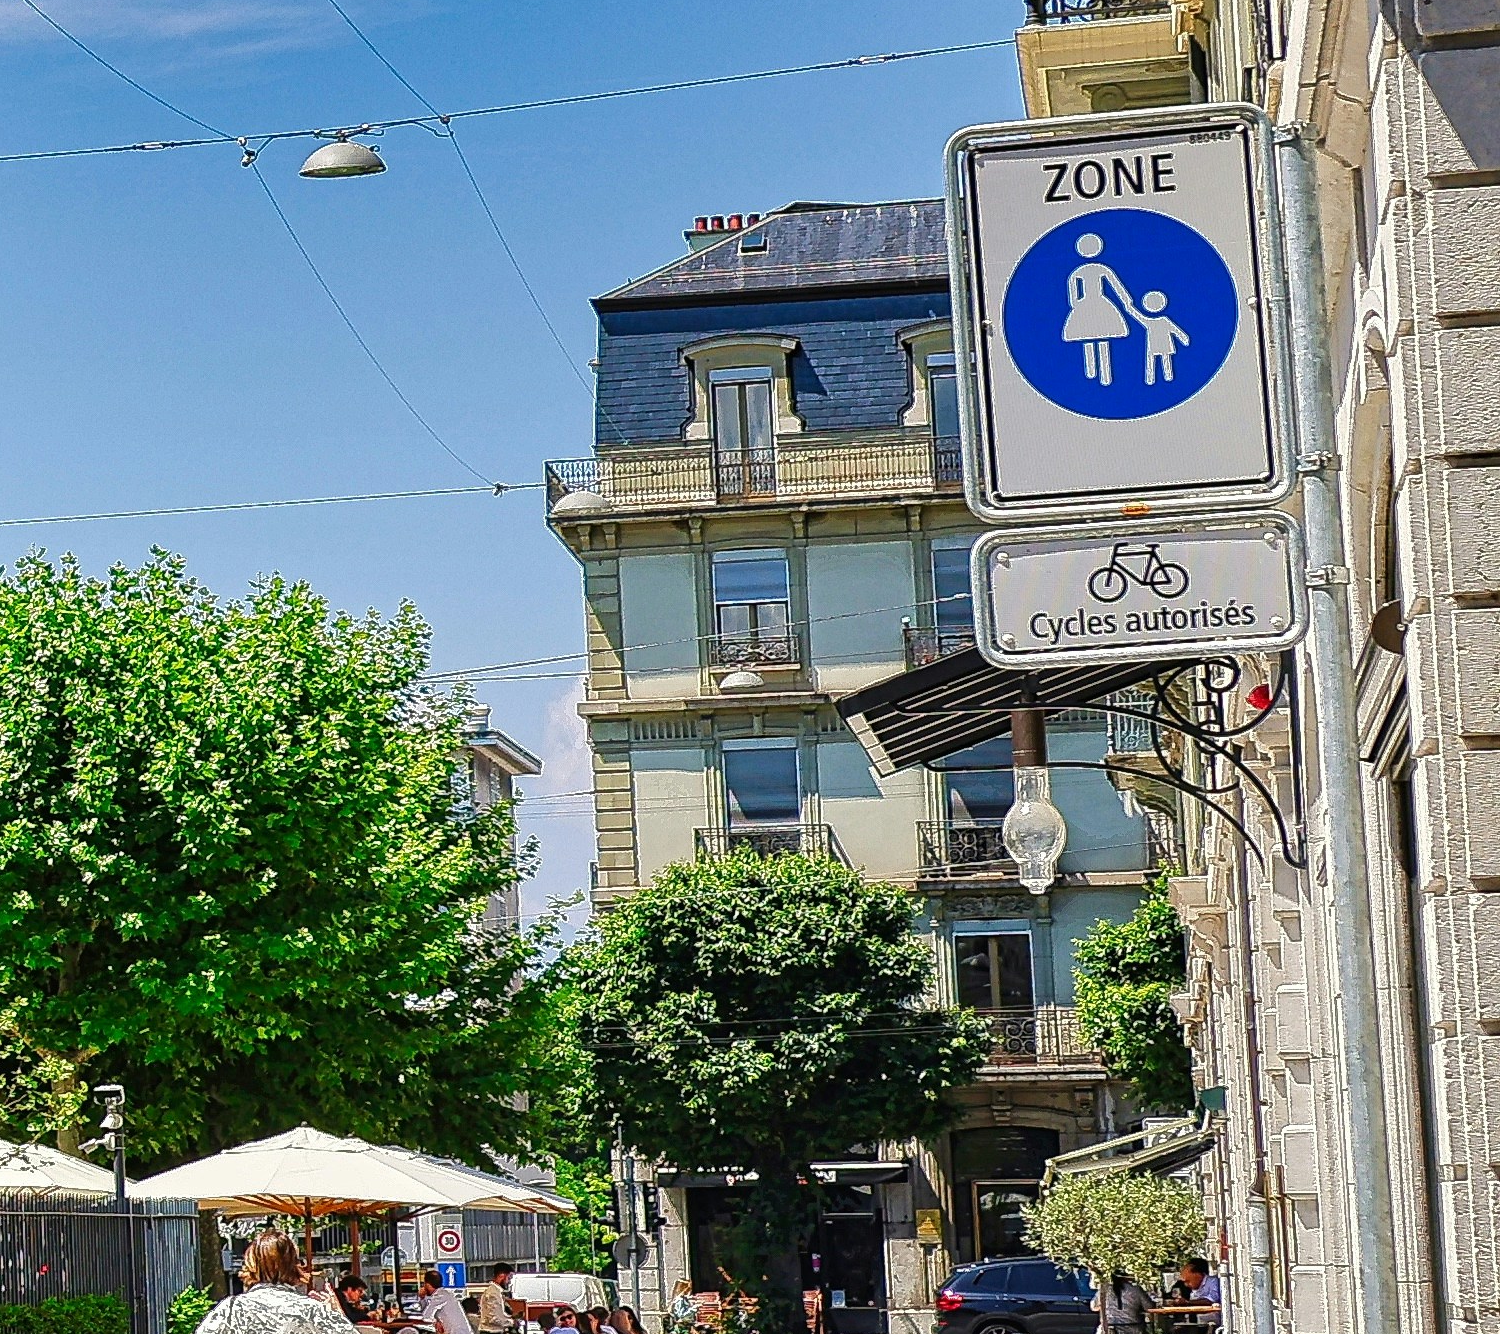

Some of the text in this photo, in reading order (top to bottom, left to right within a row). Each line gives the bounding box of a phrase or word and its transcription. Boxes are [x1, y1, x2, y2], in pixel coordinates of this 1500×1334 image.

[1043, 153, 1177, 203] ZONE
[1029, 598, 1256, 644] Cycles autorisés
[444, 1236, 455, 1246] 30
